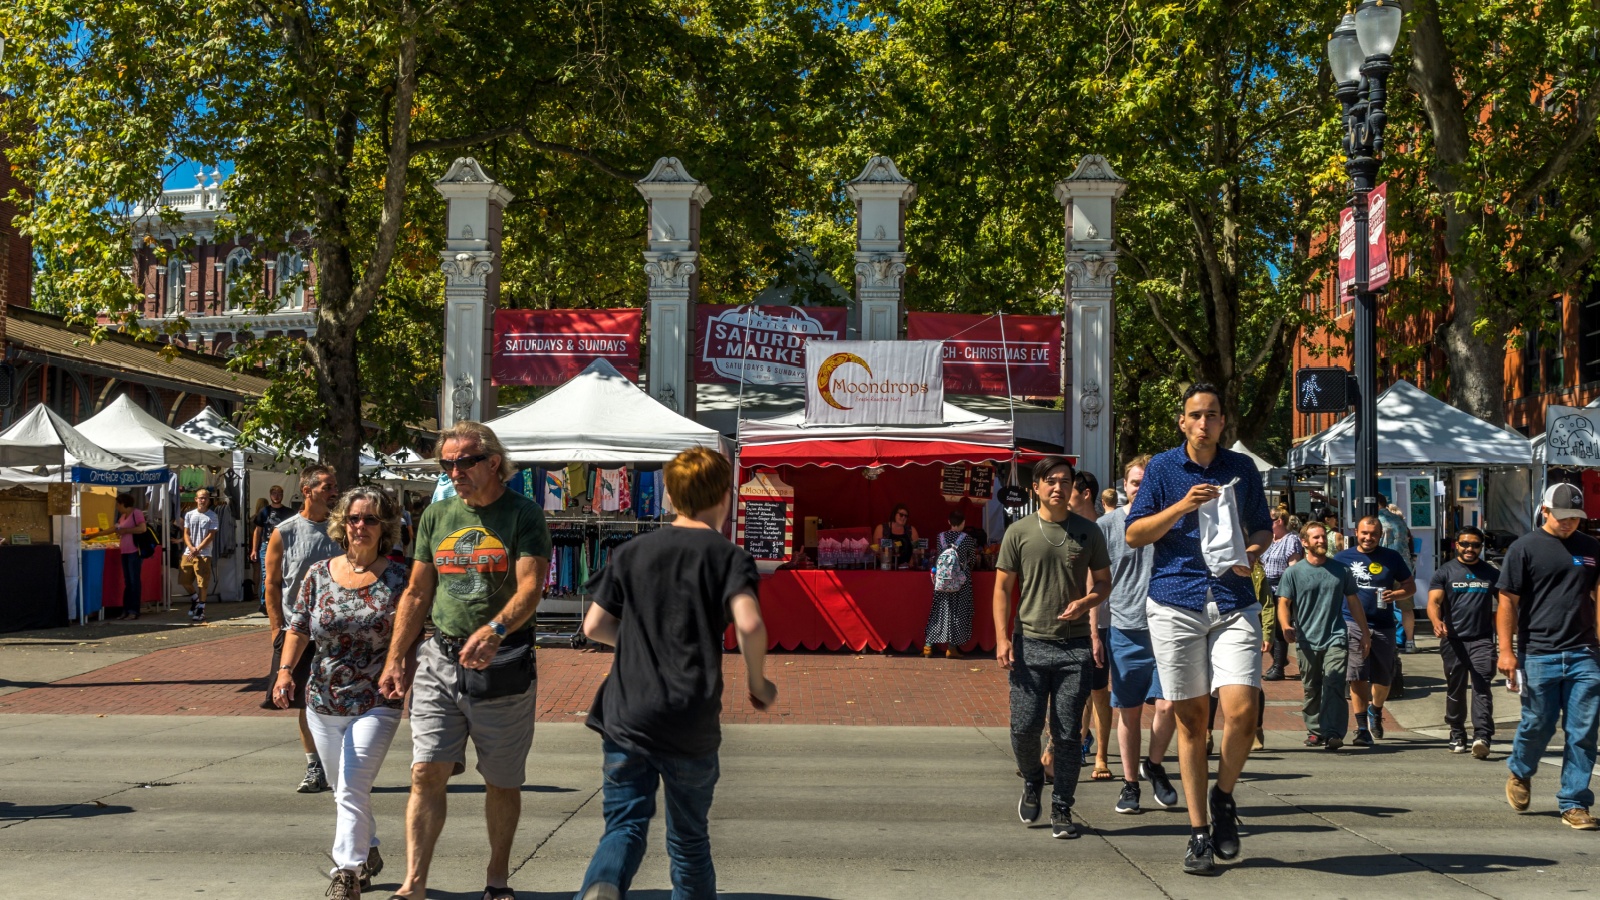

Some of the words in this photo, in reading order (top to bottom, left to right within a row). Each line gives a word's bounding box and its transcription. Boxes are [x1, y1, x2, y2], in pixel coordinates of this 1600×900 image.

[738, 317, 808, 332] PORTLAND
[505, 339, 564, 351] SATURDAYS
[566, 339, 574, 350] &
[578, 340, 627, 351] SUNDAYS
[725, 341, 806, 364] MARKE
[942, 346, 956, 359] CH
[964, 346, 1028, 361] CHRISTMAS
[1030, 348, 1050, 360] EVE
[725, 361, 764, 373] SATURDAYS
[774, 367, 805, 379] SUNDAYS
[832, 378, 929, 397] Moondrops
[745, 486, 788, 497] Moondrops
[435, 554, 503, 566] SHELBY
